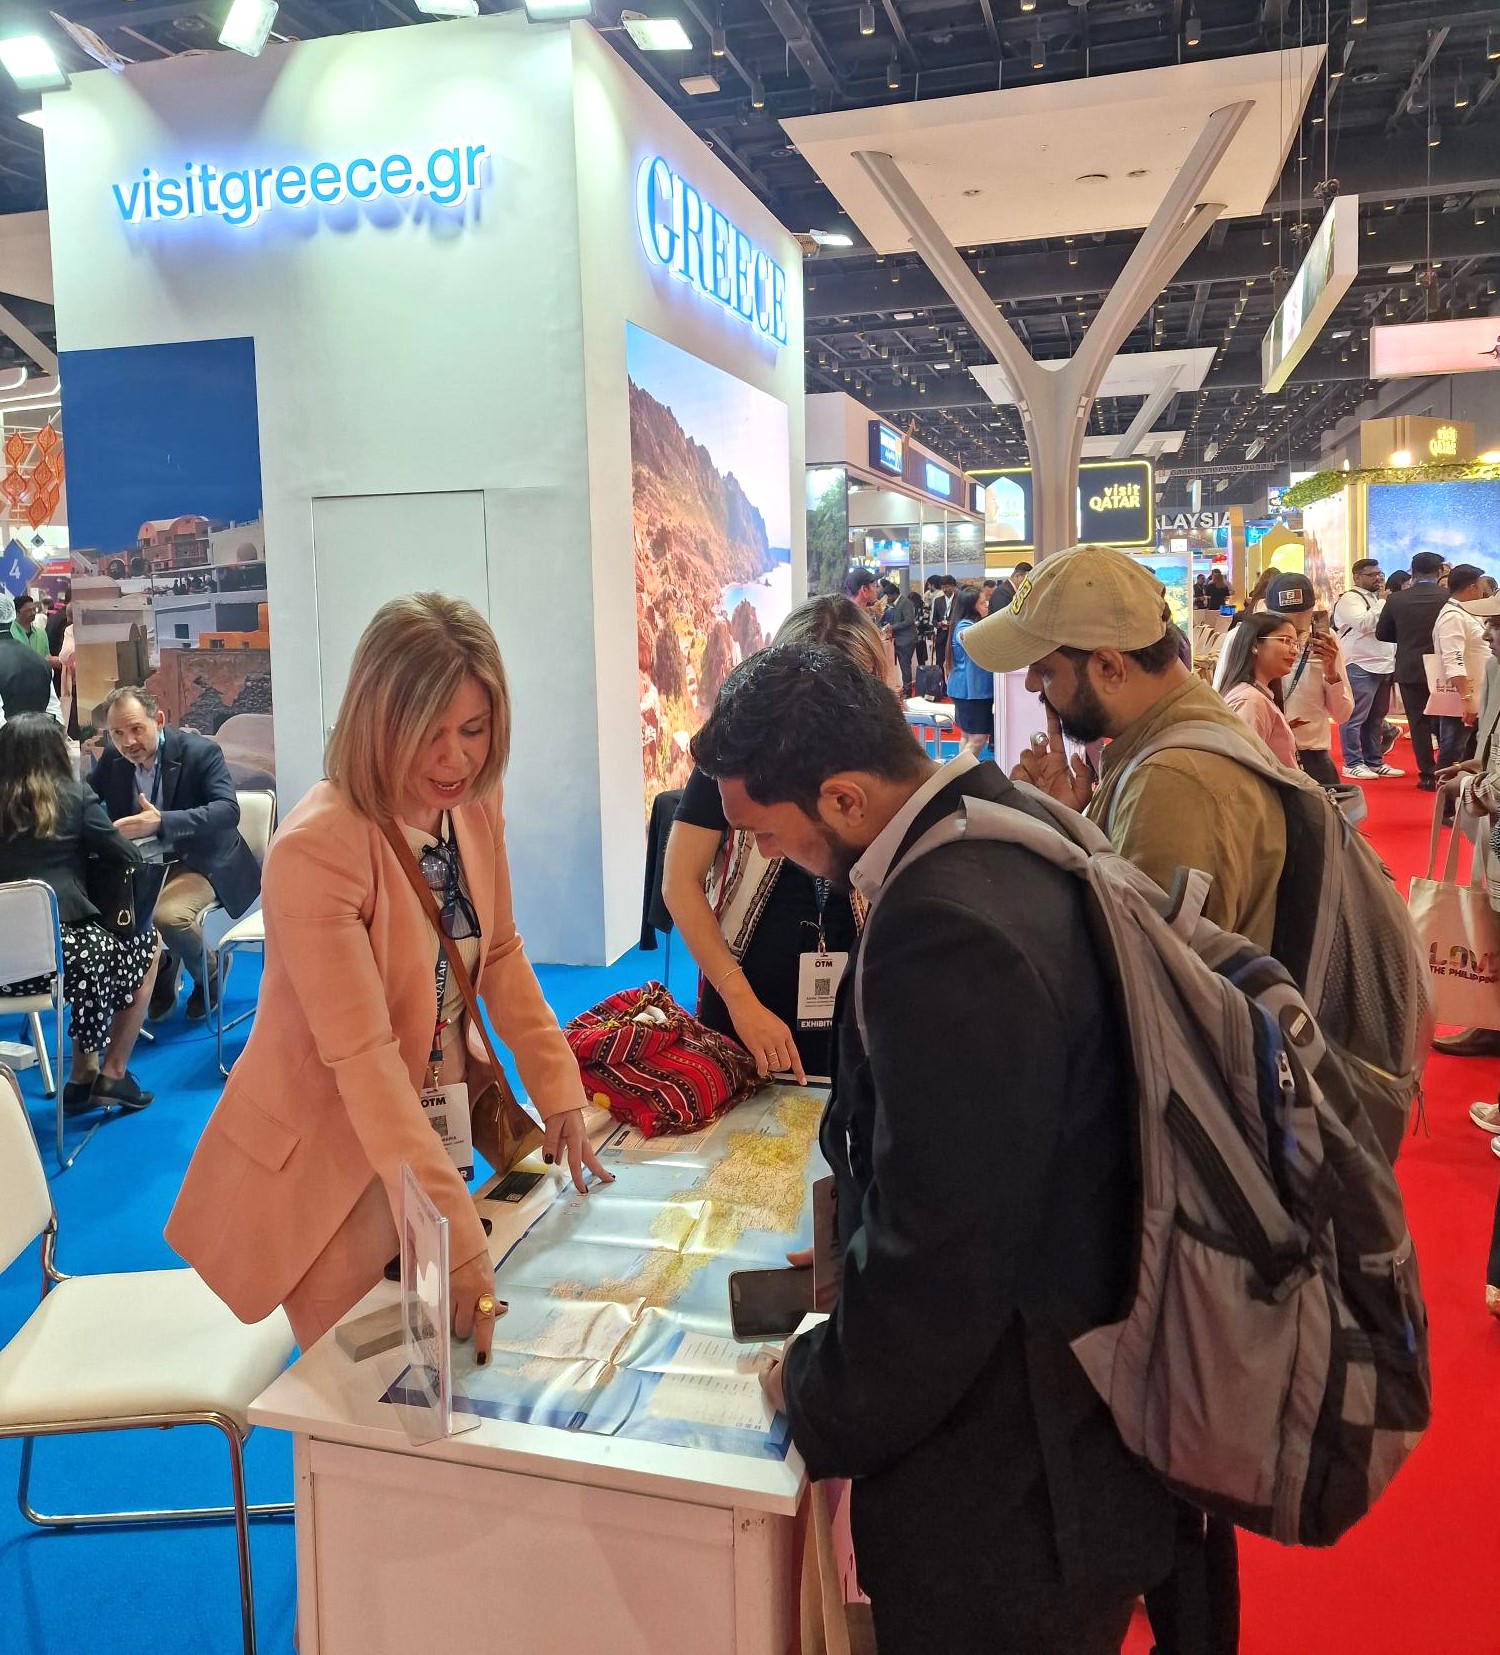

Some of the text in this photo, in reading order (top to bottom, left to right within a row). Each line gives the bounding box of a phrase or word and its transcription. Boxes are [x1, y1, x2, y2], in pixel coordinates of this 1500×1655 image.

[112, 145, 486, 226] visitgreece.gr
[640, 156, 787, 346] GREECE
[1104, 483, 1140, 496] visit
[1089, 496, 1140, 511] QATAR
[9, 558, 20, 579] 4
[1430, 966, 1445, 975] THE
[801, 1020, 832, 1028] EXHIBIT
[421, 1097, 446, 1108] OTM
